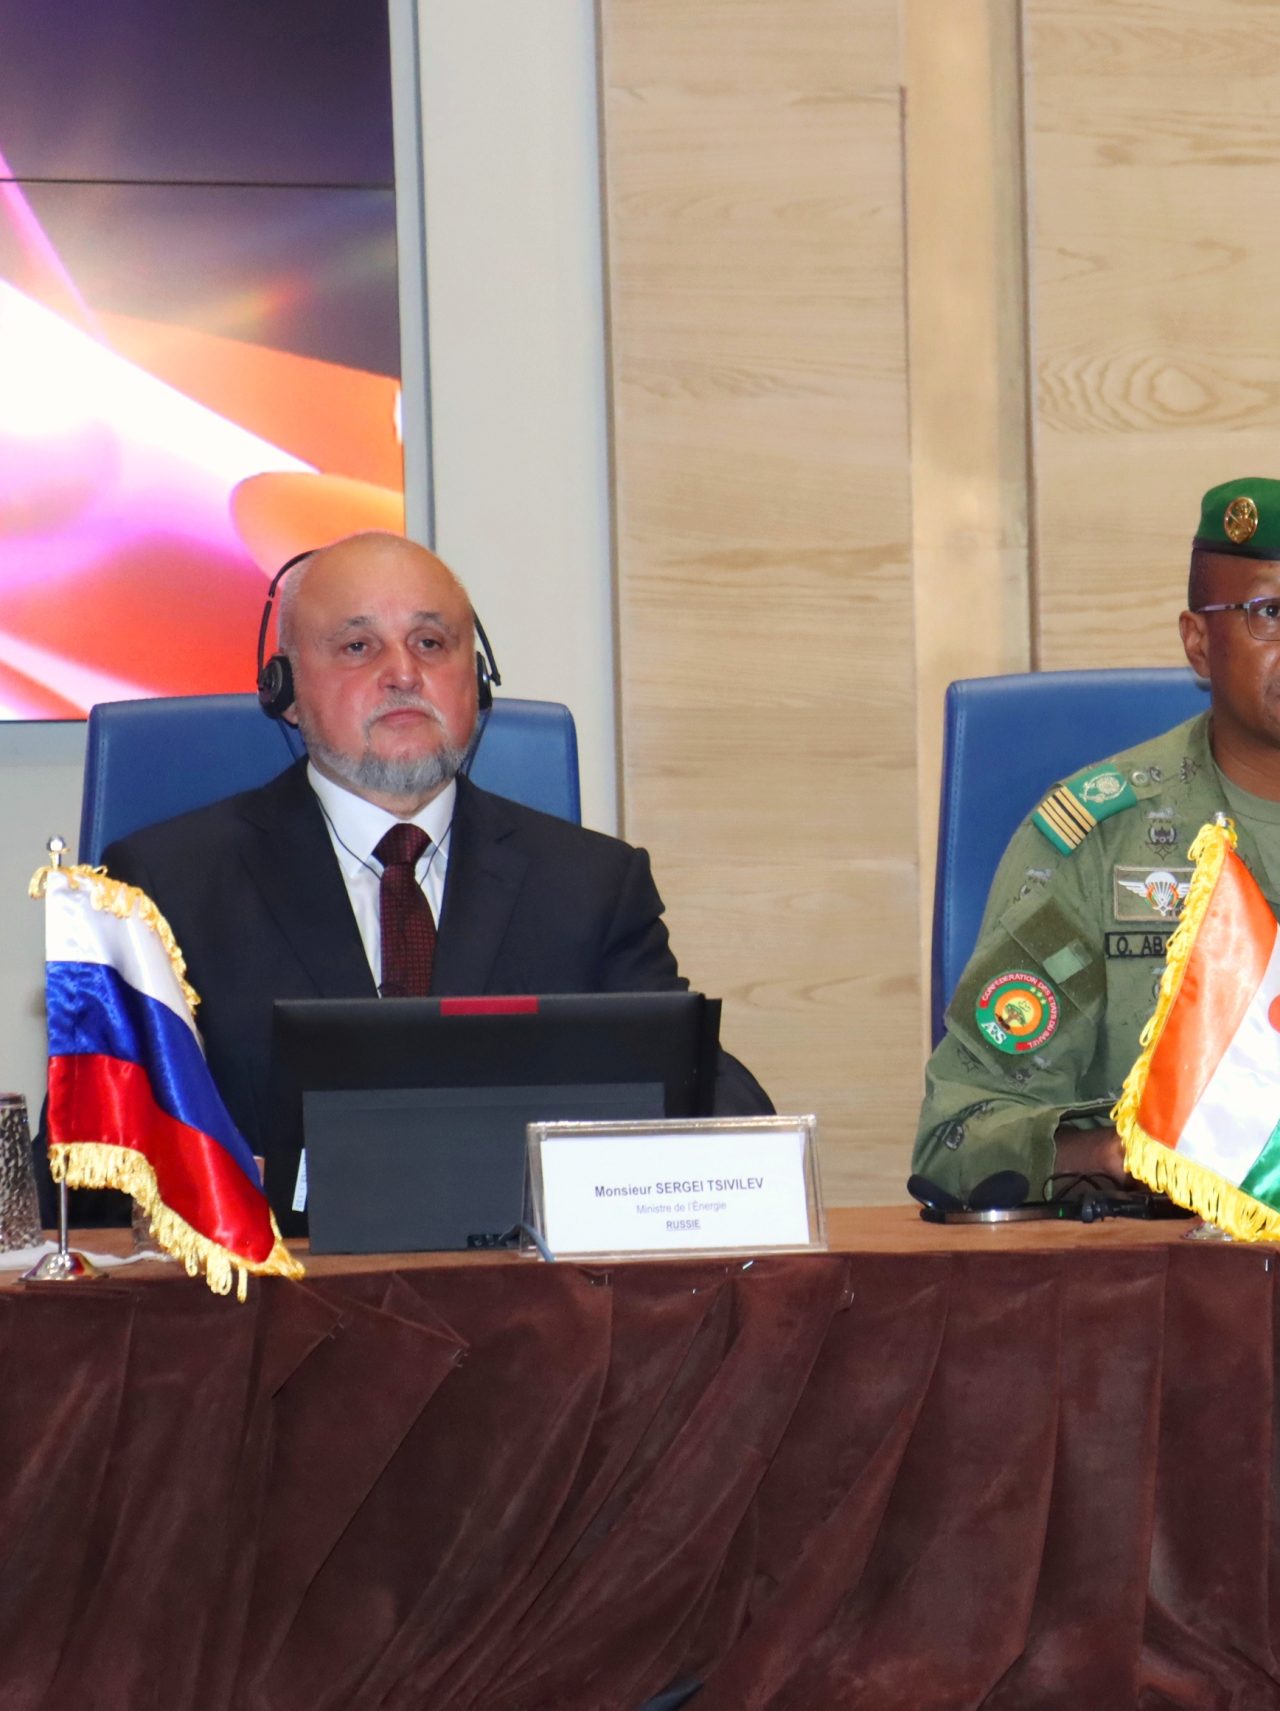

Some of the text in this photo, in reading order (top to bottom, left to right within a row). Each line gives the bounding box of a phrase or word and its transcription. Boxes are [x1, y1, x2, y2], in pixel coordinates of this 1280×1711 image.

[1116, 935, 1168, 955] O. AB
[594, 1177, 764, 1198] Monsieur SERGEI TSIVILEV
[636, 1203, 673, 1215] Ministre
[673, 1202, 686, 1212] de
[666, 1219, 700, 1230] RUSSIE
